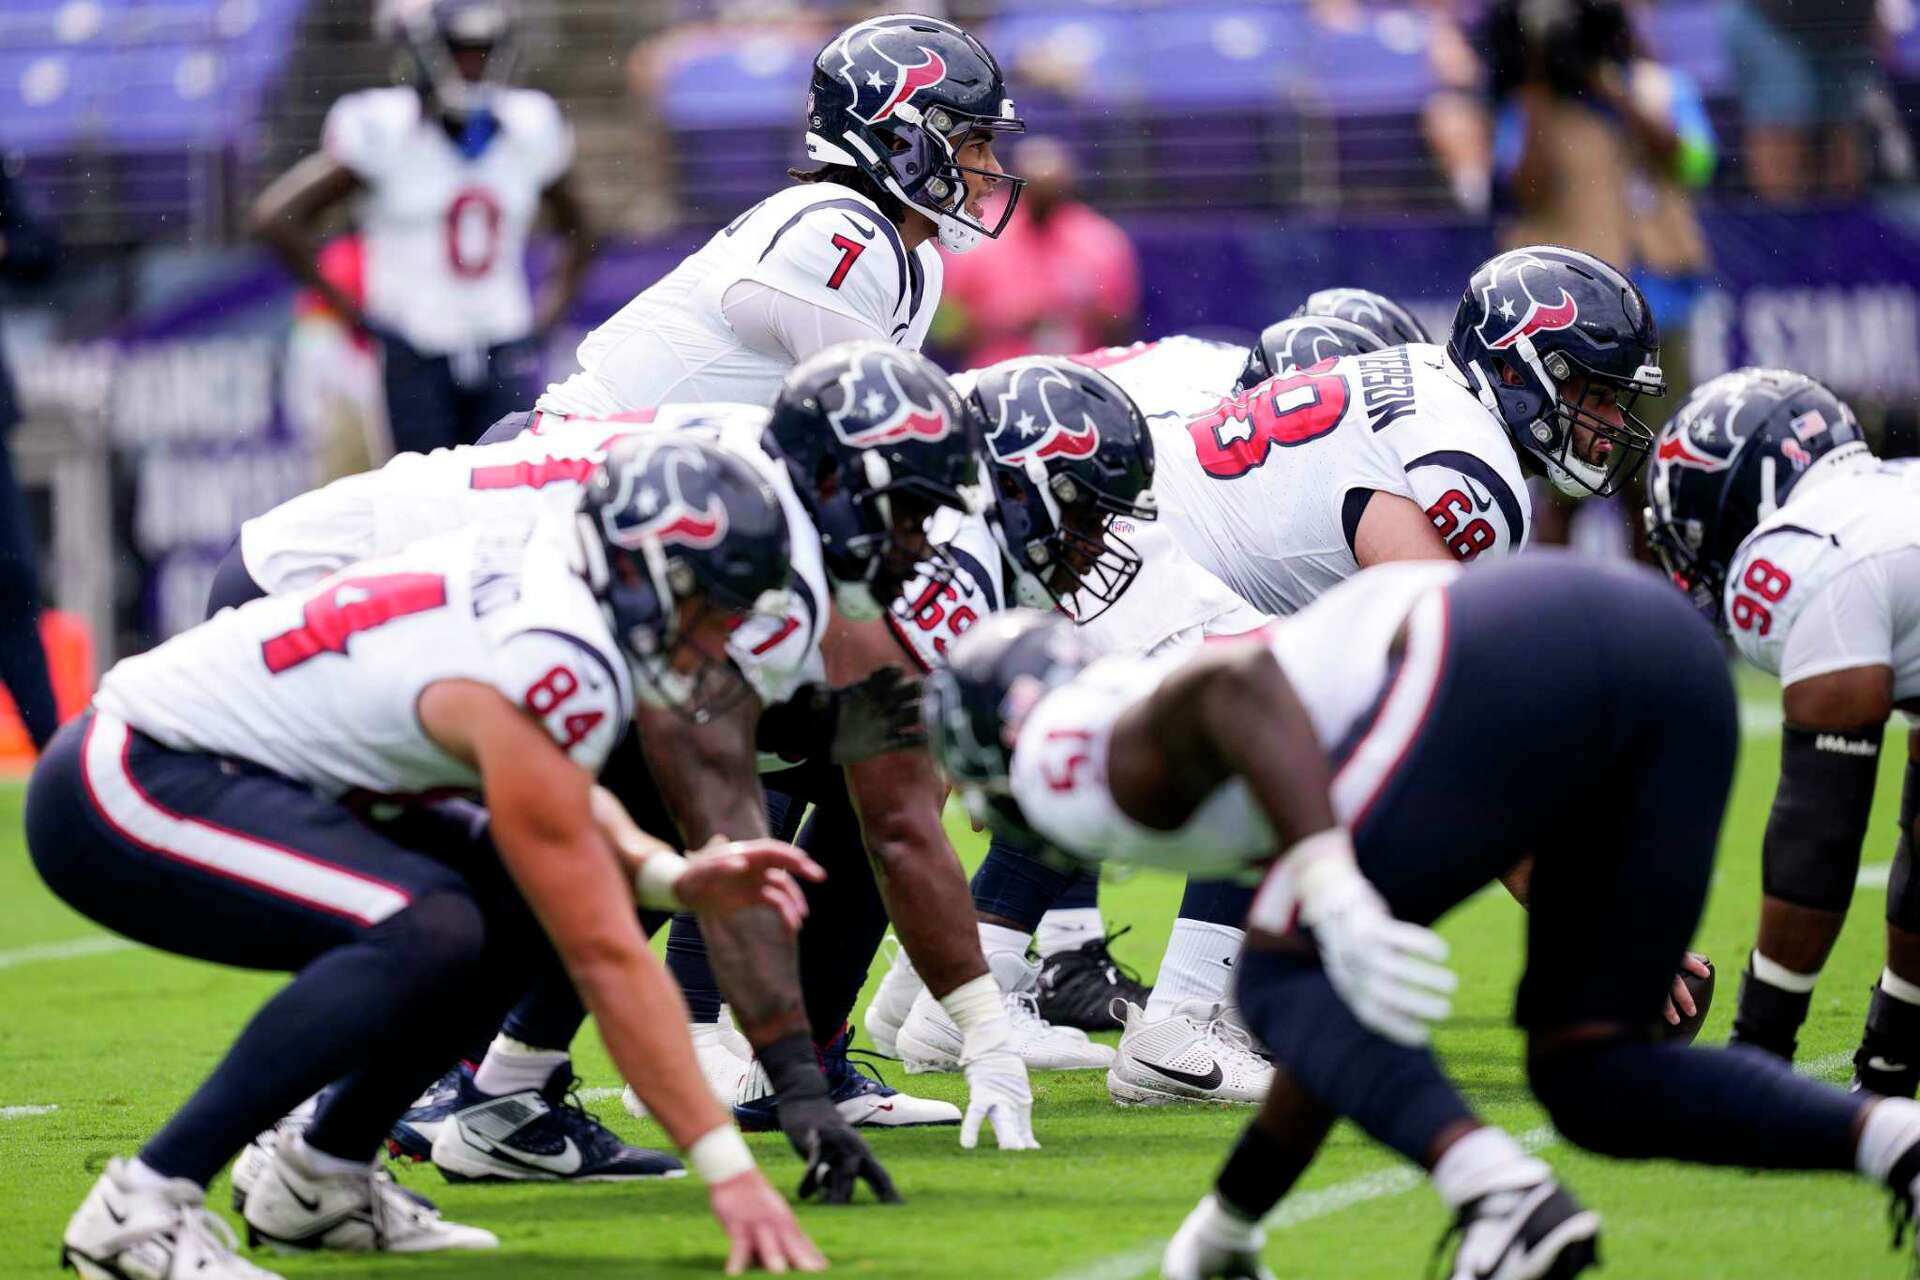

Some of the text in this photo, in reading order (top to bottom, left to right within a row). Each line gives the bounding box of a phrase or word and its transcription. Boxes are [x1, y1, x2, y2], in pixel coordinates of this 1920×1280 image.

[826, 232, 866, 291] 7
[1185, 355, 1351, 480] 8
[1425, 488, 1497, 562] 68
[1732, 558, 1792, 637] 98
[526, 665, 605, 752] 84
